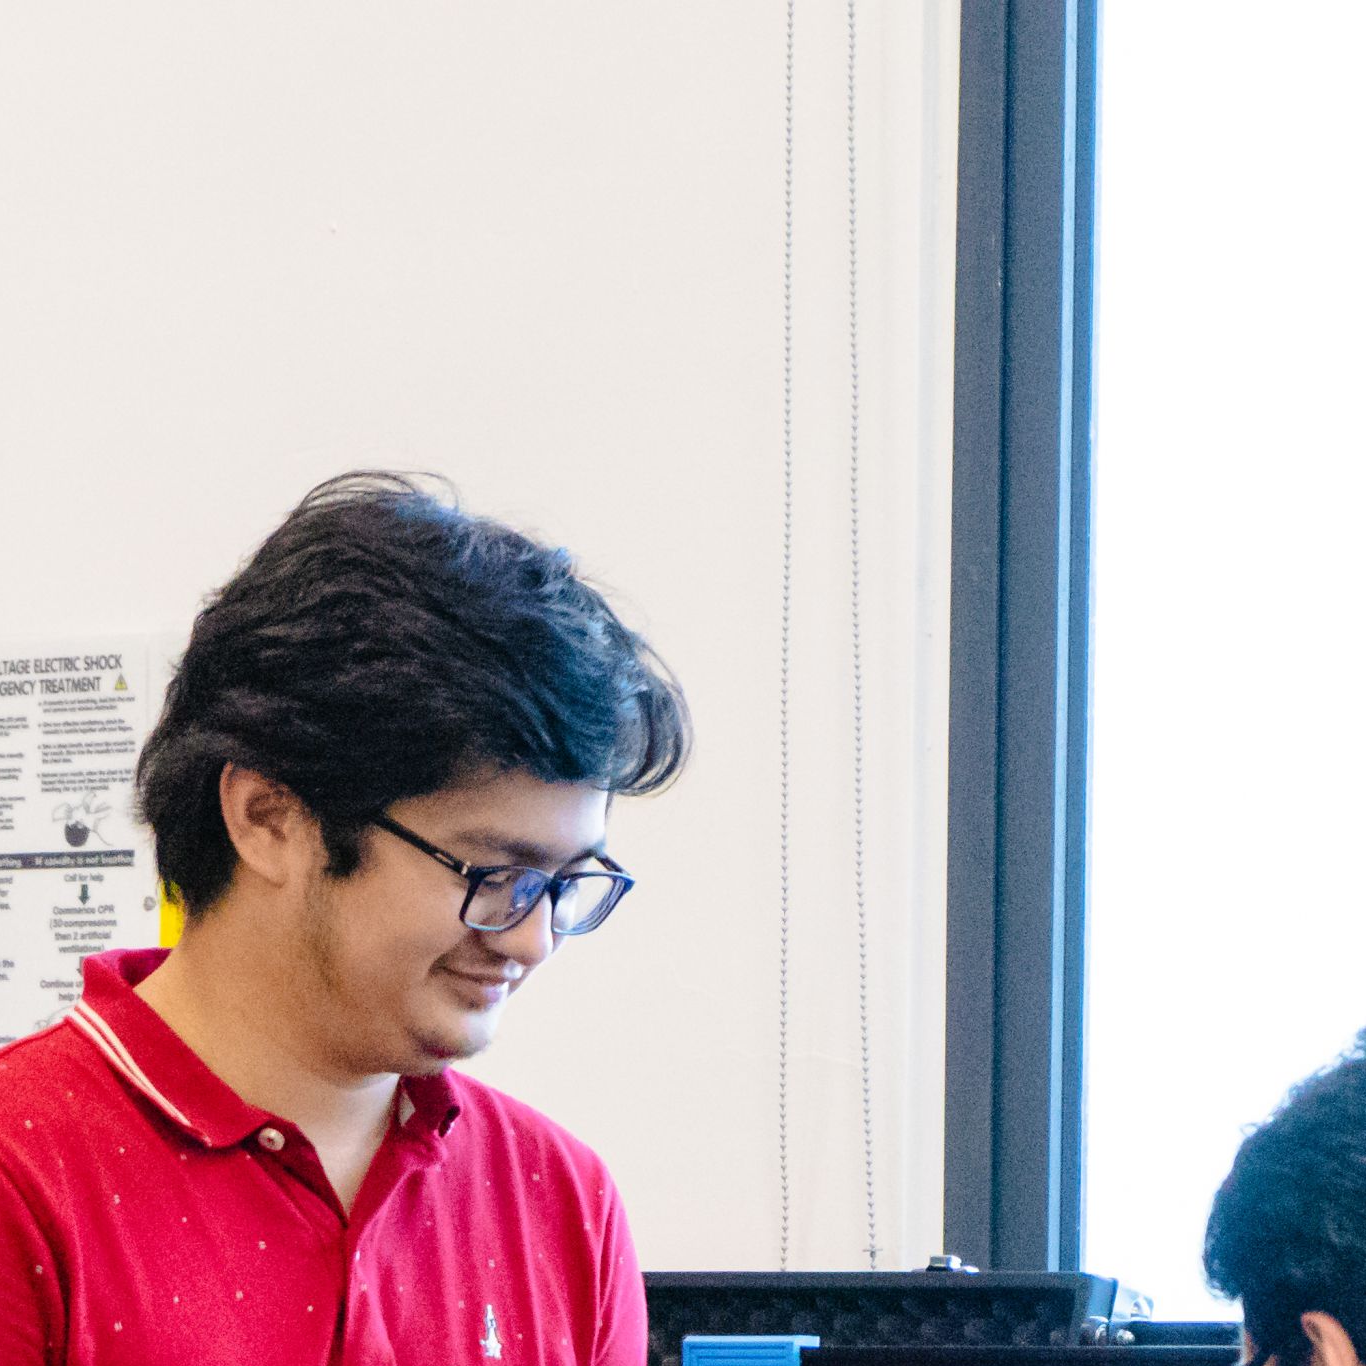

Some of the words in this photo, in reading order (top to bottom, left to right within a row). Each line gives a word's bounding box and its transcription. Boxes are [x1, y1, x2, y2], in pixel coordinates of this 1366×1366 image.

[34, 657, 81, 674] ELECTRIC
[84, 654, 122, 671] SHOCK
[39, 677, 101, 694] TREATMENT
[64, 873, 77, 882] Call
[79, 873, 88, 881] for
[90, 873, 104, 882] help
[53, 906, 95, 915] Commence
[98, 904, 116, 914] CPR
[55, 932, 72, 941] then
[2, 959, 14, 968] the
[39, 980, 74, 989] Continue
[58, 993, 74, 1002] help
